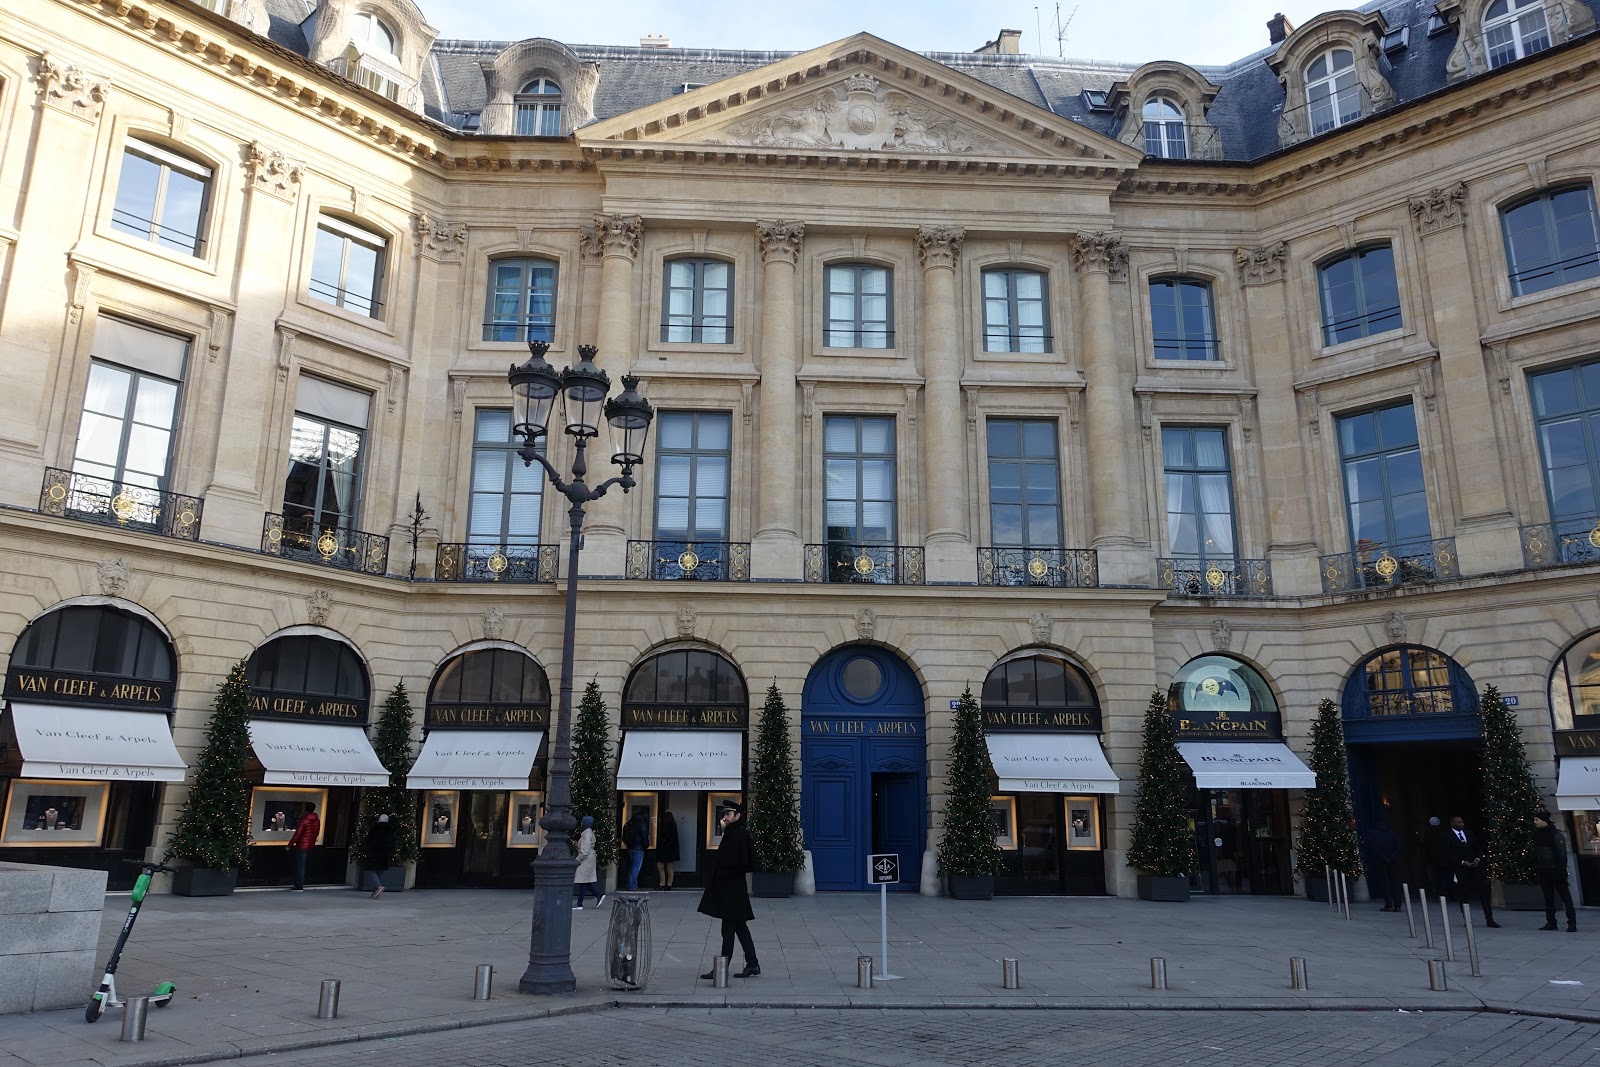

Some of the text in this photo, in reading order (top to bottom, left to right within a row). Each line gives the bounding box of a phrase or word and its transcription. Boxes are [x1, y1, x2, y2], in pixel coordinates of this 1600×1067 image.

[18, 674, 161, 702] VAN CLEEF & ARPELS
[274, 698, 308, 714] CLEEF
[317, 702, 358, 718] ARPELS
[1505, 697, 1516, 705] 20
[436, 709, 456, 722] VAN
[460, 709, 493, 722] CLEEF
[503, 709, 542, 723] ARPELS
[632, 710, 653, 723] VAN
[658, 710, 690, 723] CLEEF
[700, 710, 738, 724] ARPELS
[986, 712, 1006, 724] VAN
[1011, 712, 1042, 725] CLEEF
[1052, 713, 1090, 726] ARPELS
[810, 720, 830, 734] VAN
[836, 720, 867, 734] CLEEF
[876, 722, 916, 734] ARPELS
[1180, 720, 1268, 731] BLANCPAIN
[35, 728, 62, 737] Van
[66, 730, 100, 740] Cleef
[118, 734, 158, 744] Arpels
[1568, 736, 1597, 749] VAN
[266, 742, 287, 750] Van
[289, 744, 316, 752] Cleef
[330, 747, 360, 756] Arpels
[59, 764, 155, 778] Van Cleef & Arpels
[292, 772, 308, 781] Van
[310, 773, 331, 782] Cleef
[341, 774, 366, 784] Arpels
[432, 778, 446, 786] Van
[448, 778, 470, 786] Cleef
[480, 778, 504, 788] Arpels
[644, 778, 659, 786] Van
[660, 778, 682, 787] Cleef
[691, 779, 716, 788] Arpels
[1024, 780, 1039, 788] Van
[1040, 780, 1062, 789] Cleef
[1071, 782, 1095, 791] Arpels
